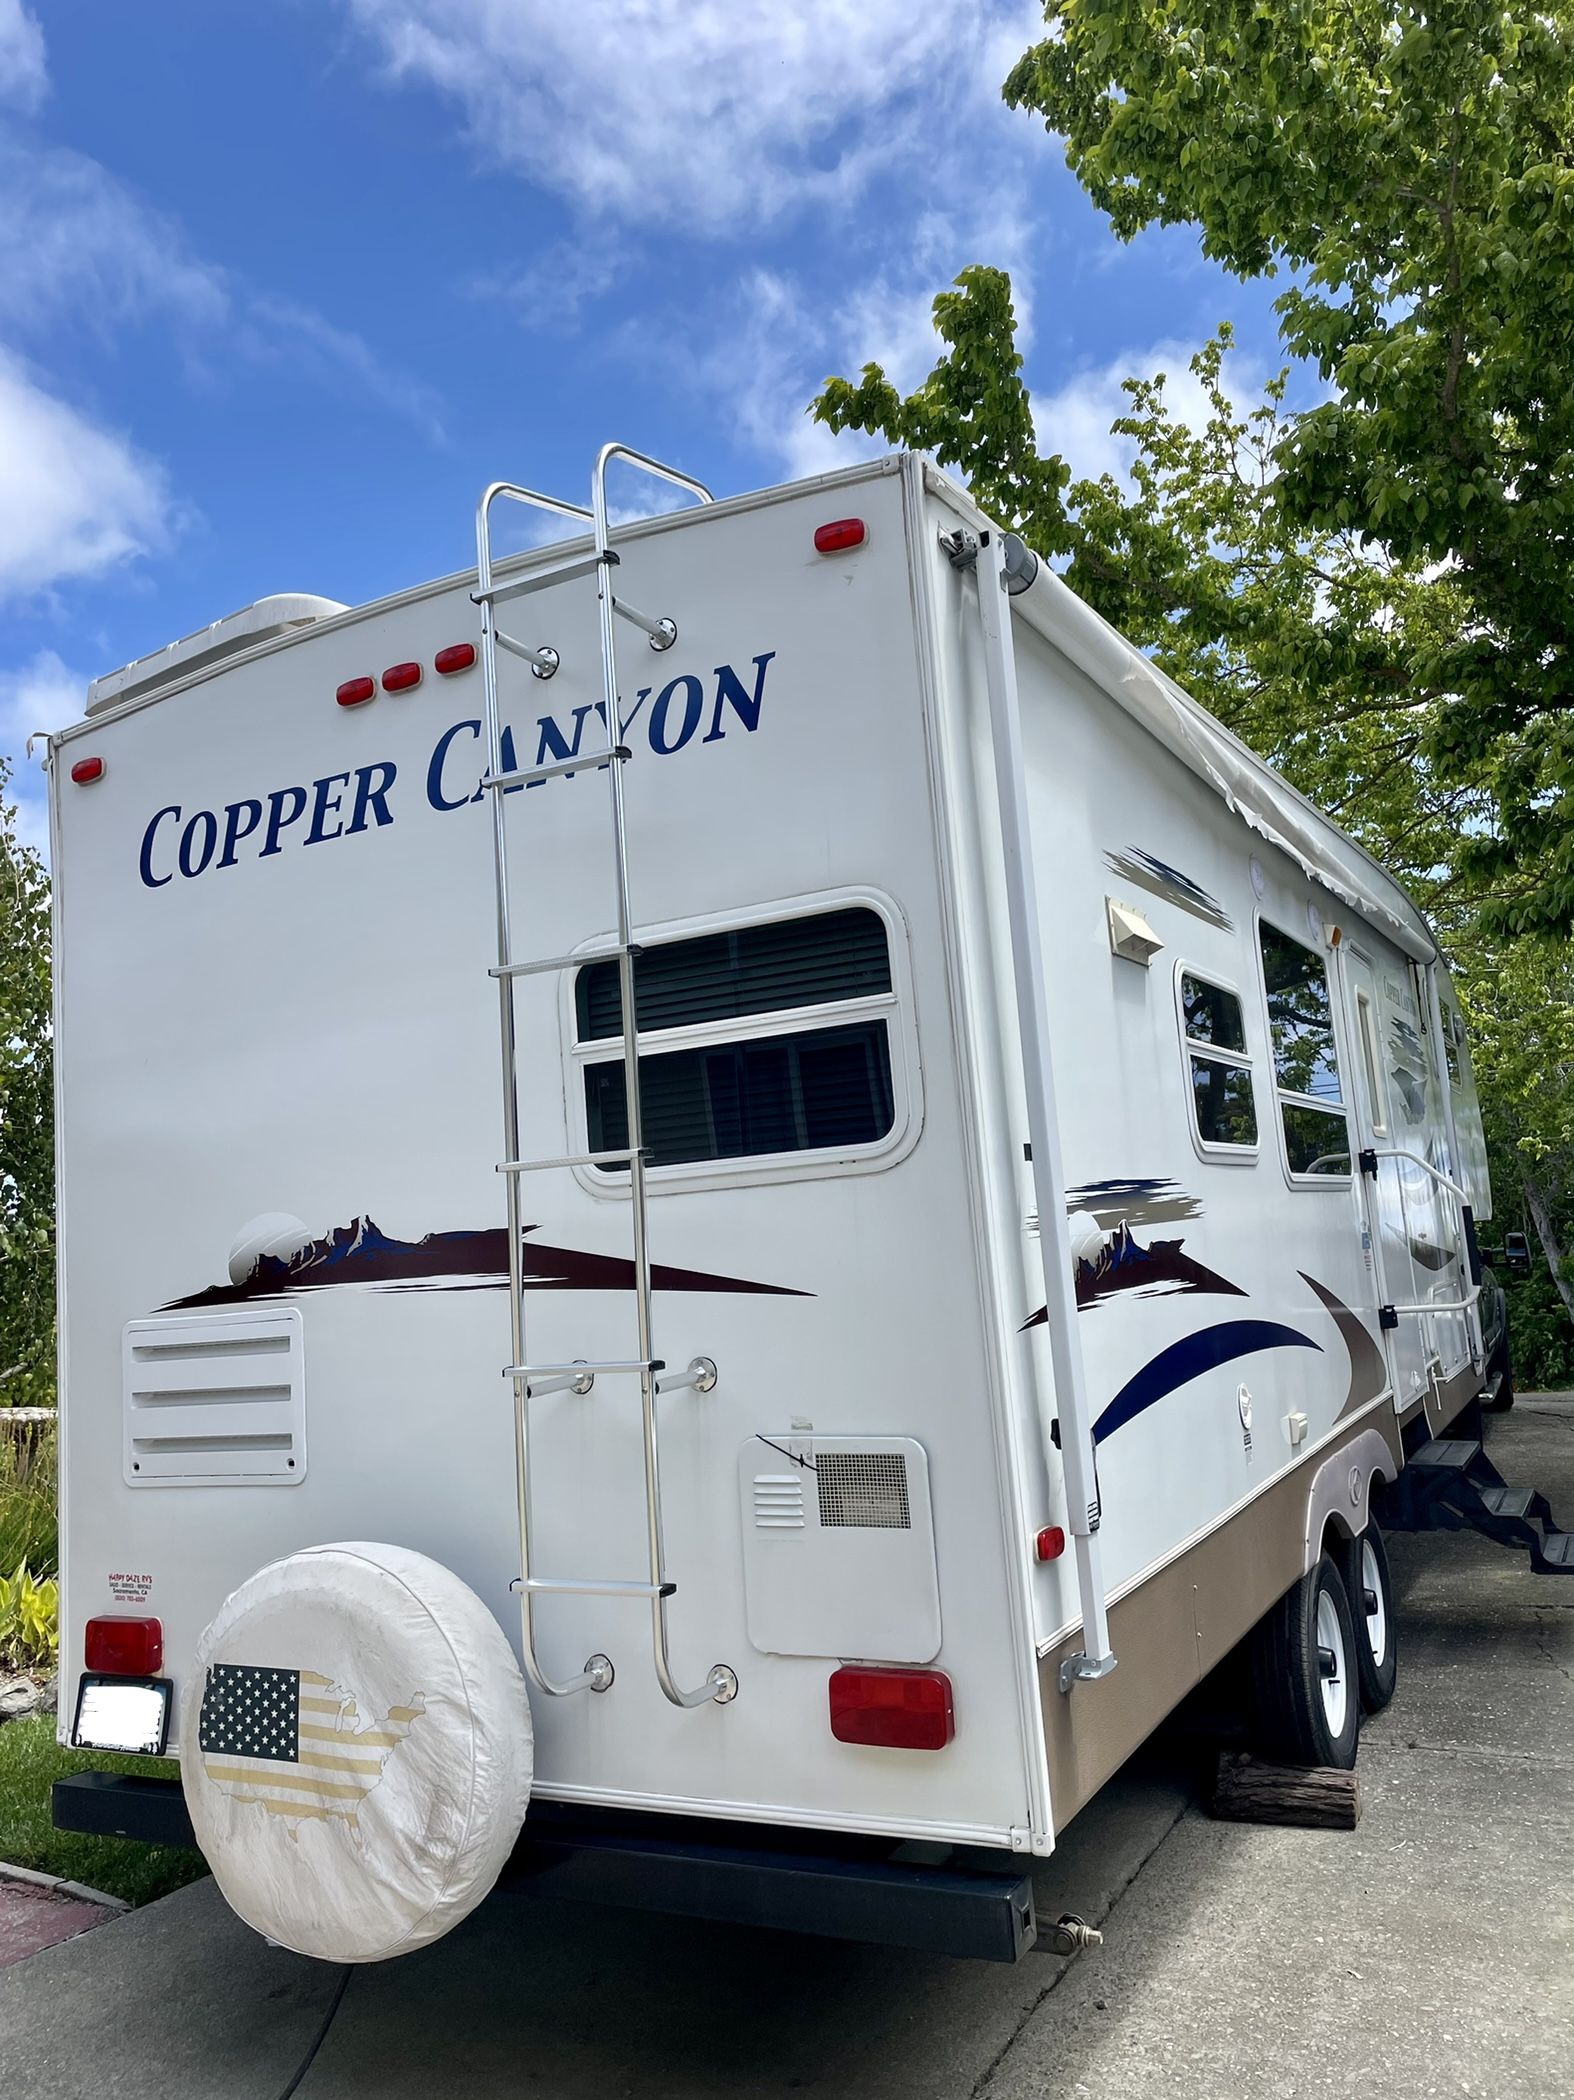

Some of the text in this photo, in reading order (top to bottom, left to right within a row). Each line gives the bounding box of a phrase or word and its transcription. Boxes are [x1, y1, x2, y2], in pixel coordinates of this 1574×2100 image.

[140, 761, 398, 888] COPPER
[109, 1574, 124, 1582] HAPPY
[126, 1574, 140, 1583] DAZE
